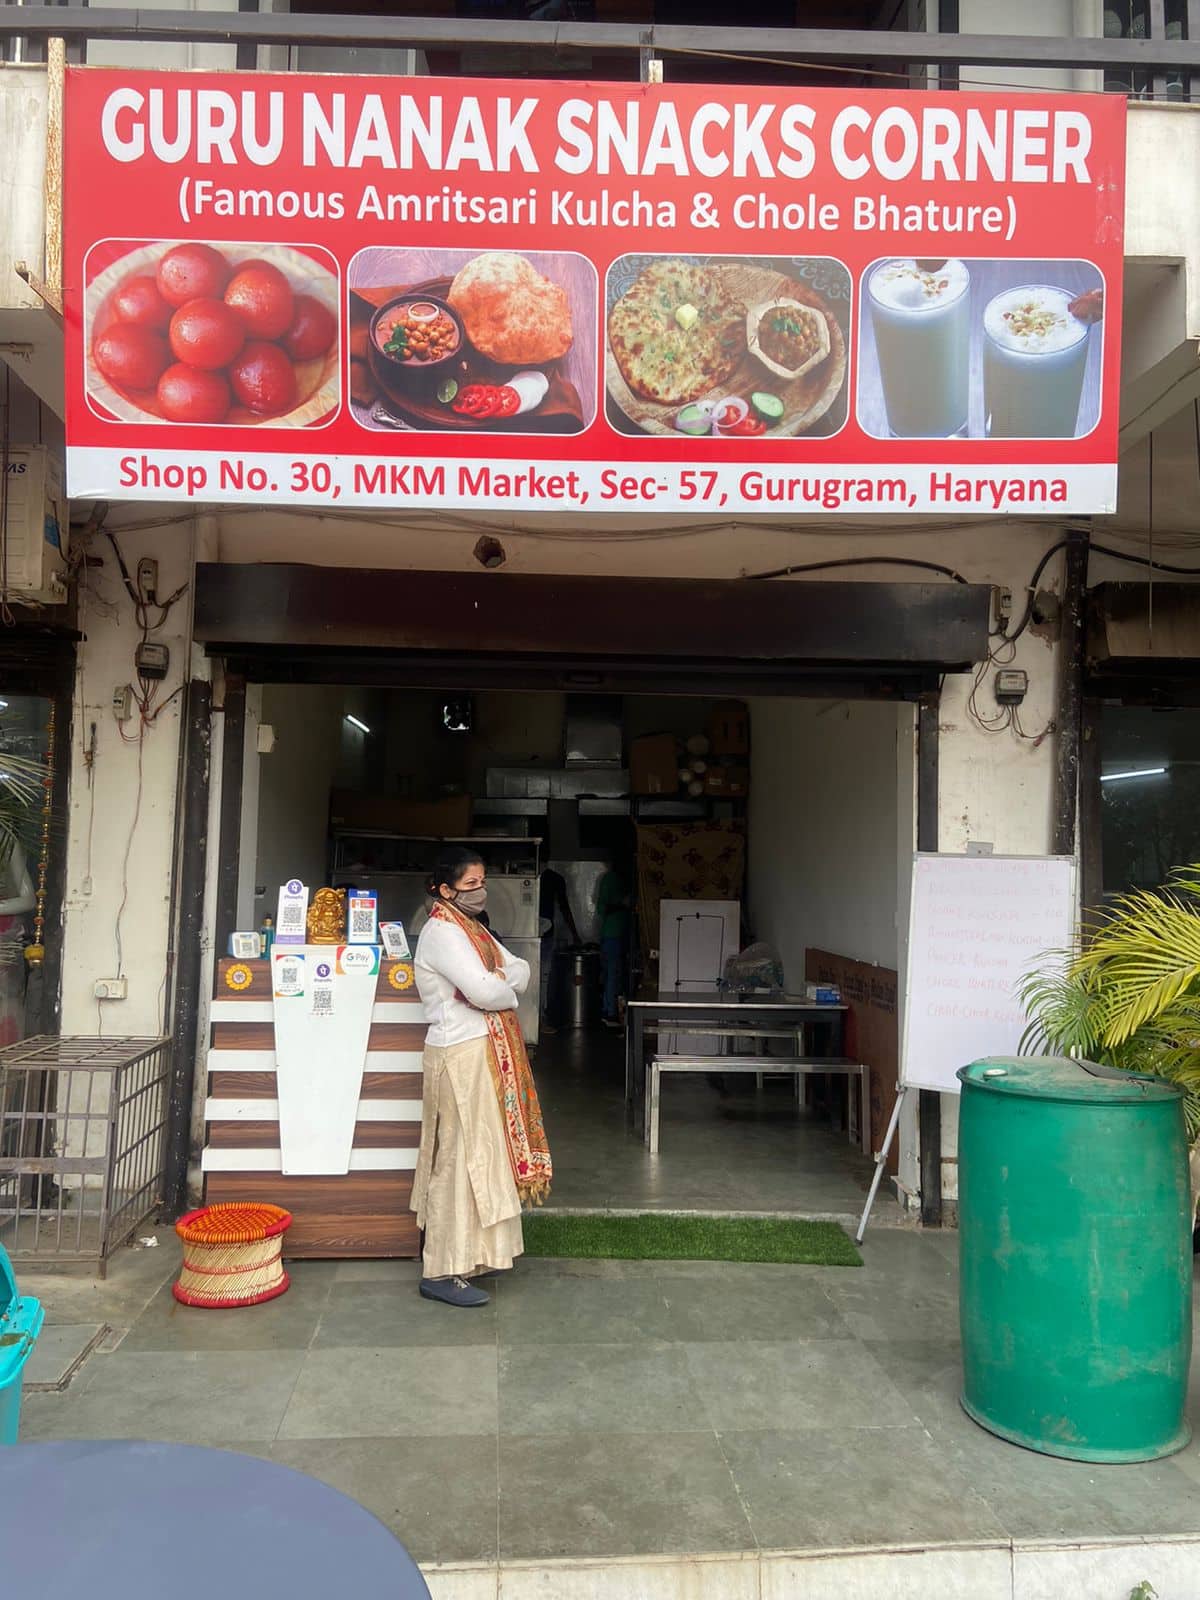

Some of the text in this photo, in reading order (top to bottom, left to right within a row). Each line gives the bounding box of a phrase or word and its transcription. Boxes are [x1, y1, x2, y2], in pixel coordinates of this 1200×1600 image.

[102, 88, 1091, 183] GURU NANAK SNACKS CORNER
[180, 177, 1016, 240] (Famous Amritsari Kulcha & Chole Bhature)
[120, 456, 1067, 508] Shop No. 30, MKM Market, Sec- 57, Gurugram, Haryana
